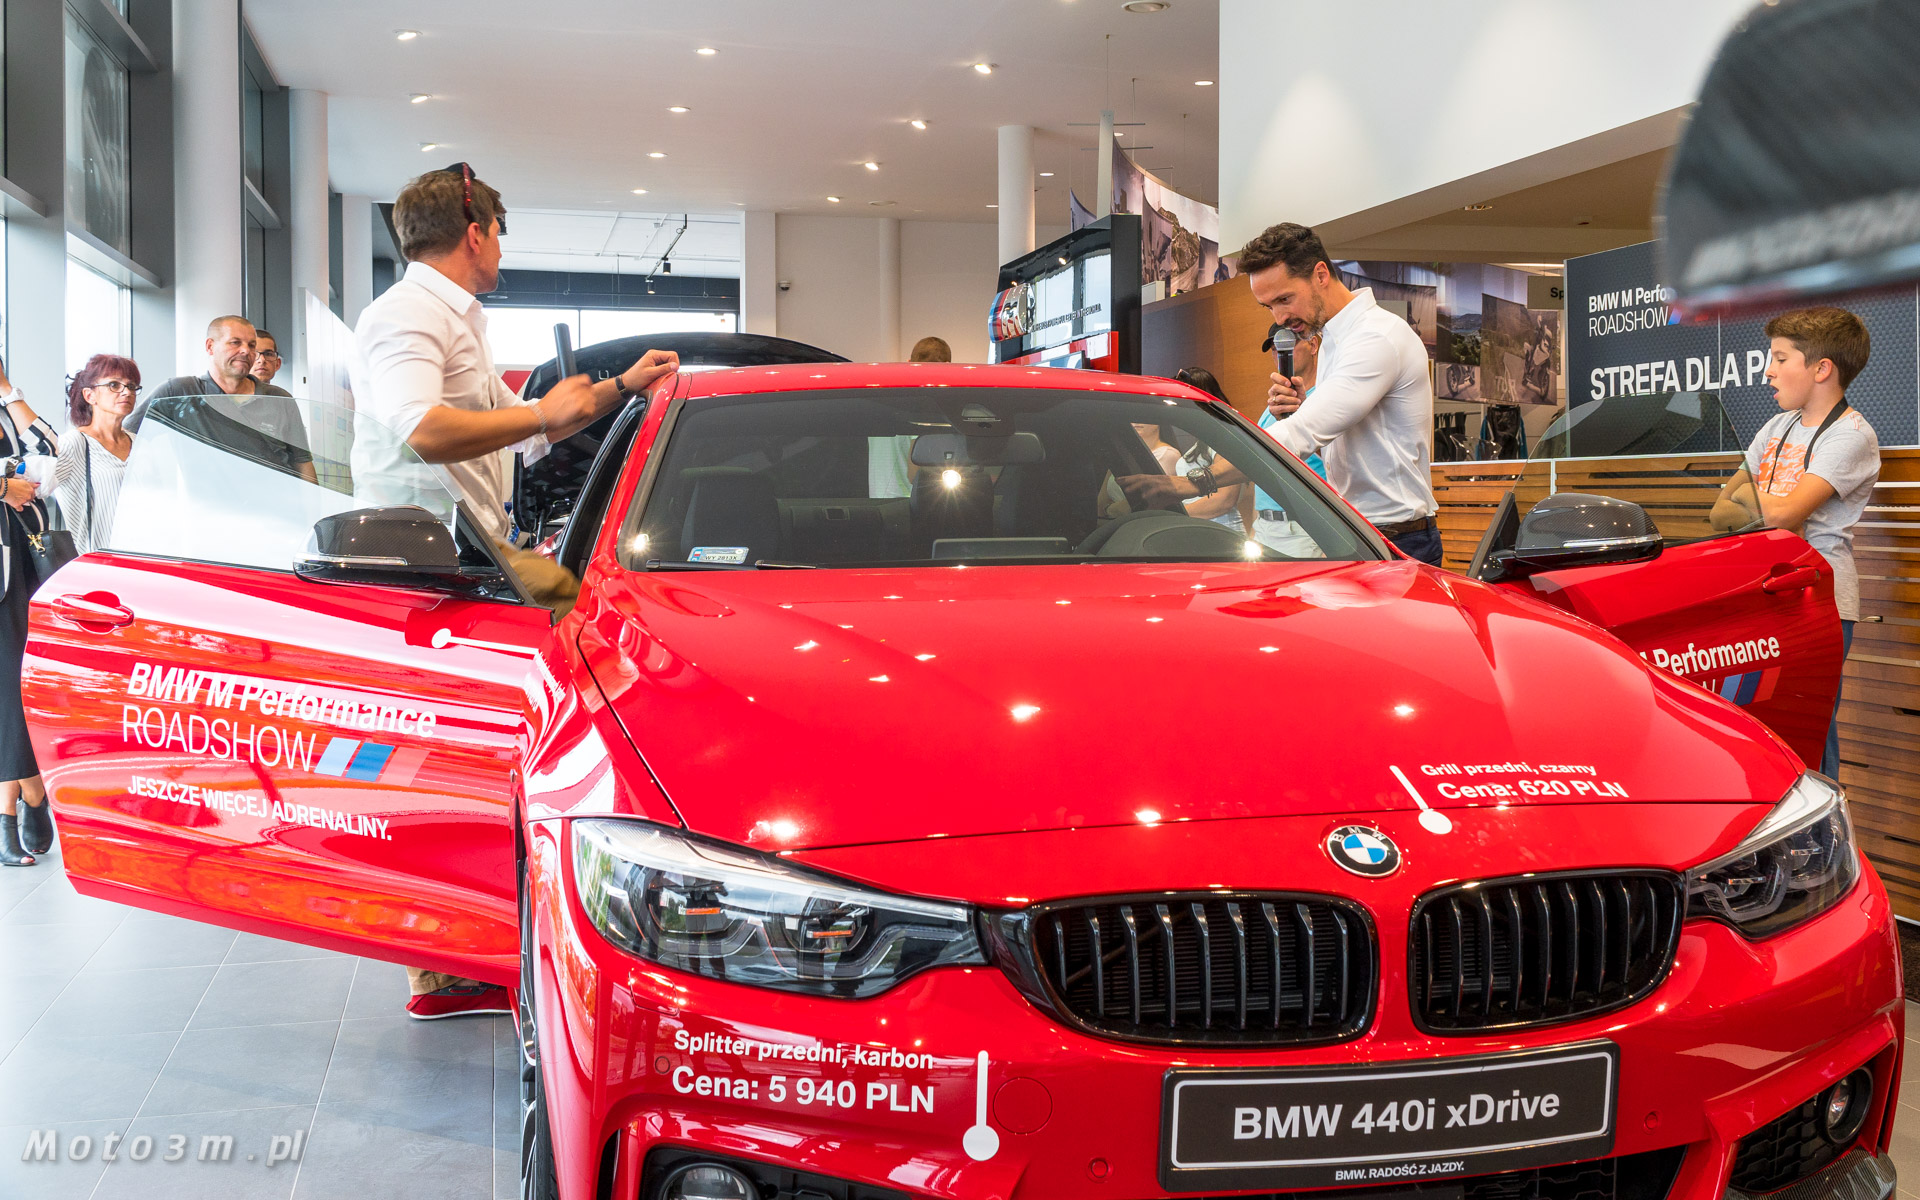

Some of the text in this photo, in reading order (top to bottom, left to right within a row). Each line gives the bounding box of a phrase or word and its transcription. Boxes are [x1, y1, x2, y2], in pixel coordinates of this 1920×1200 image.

[1588, 284, 1669, 313] BMW M Perfo
[1588, 305, 1668, 337] ROADSHOW
[1590, 360, 1681, 401] STREFA
[1686, 352, 1741, 392] DLA
[1652, 636, 1781, 676] Performance
[127, 662, 436, 738] BMW M Performance
[122, 705, 316, 772] ROADSHOW
[1420, 761, 1597, 776] Grill przedni, czarny
[128, 775, 392, 841] JESZCZE WIĘCEJ ADRENALINY.
[1437, 780, 1629, 799] Cena: 620 PLN
[1330, 826, 1386, 842] BMW
[674, 1029, 933, 1070] Splitter przedni, karbon
[672, 1066, 934, 1114] Cena: 5 940 PLN
[1233, 1089, 1561, 1140] BMW 440i xDrive
[1335, 1161, 1465, 1181] BMW. RADOŚĆ Z JAZDY.
